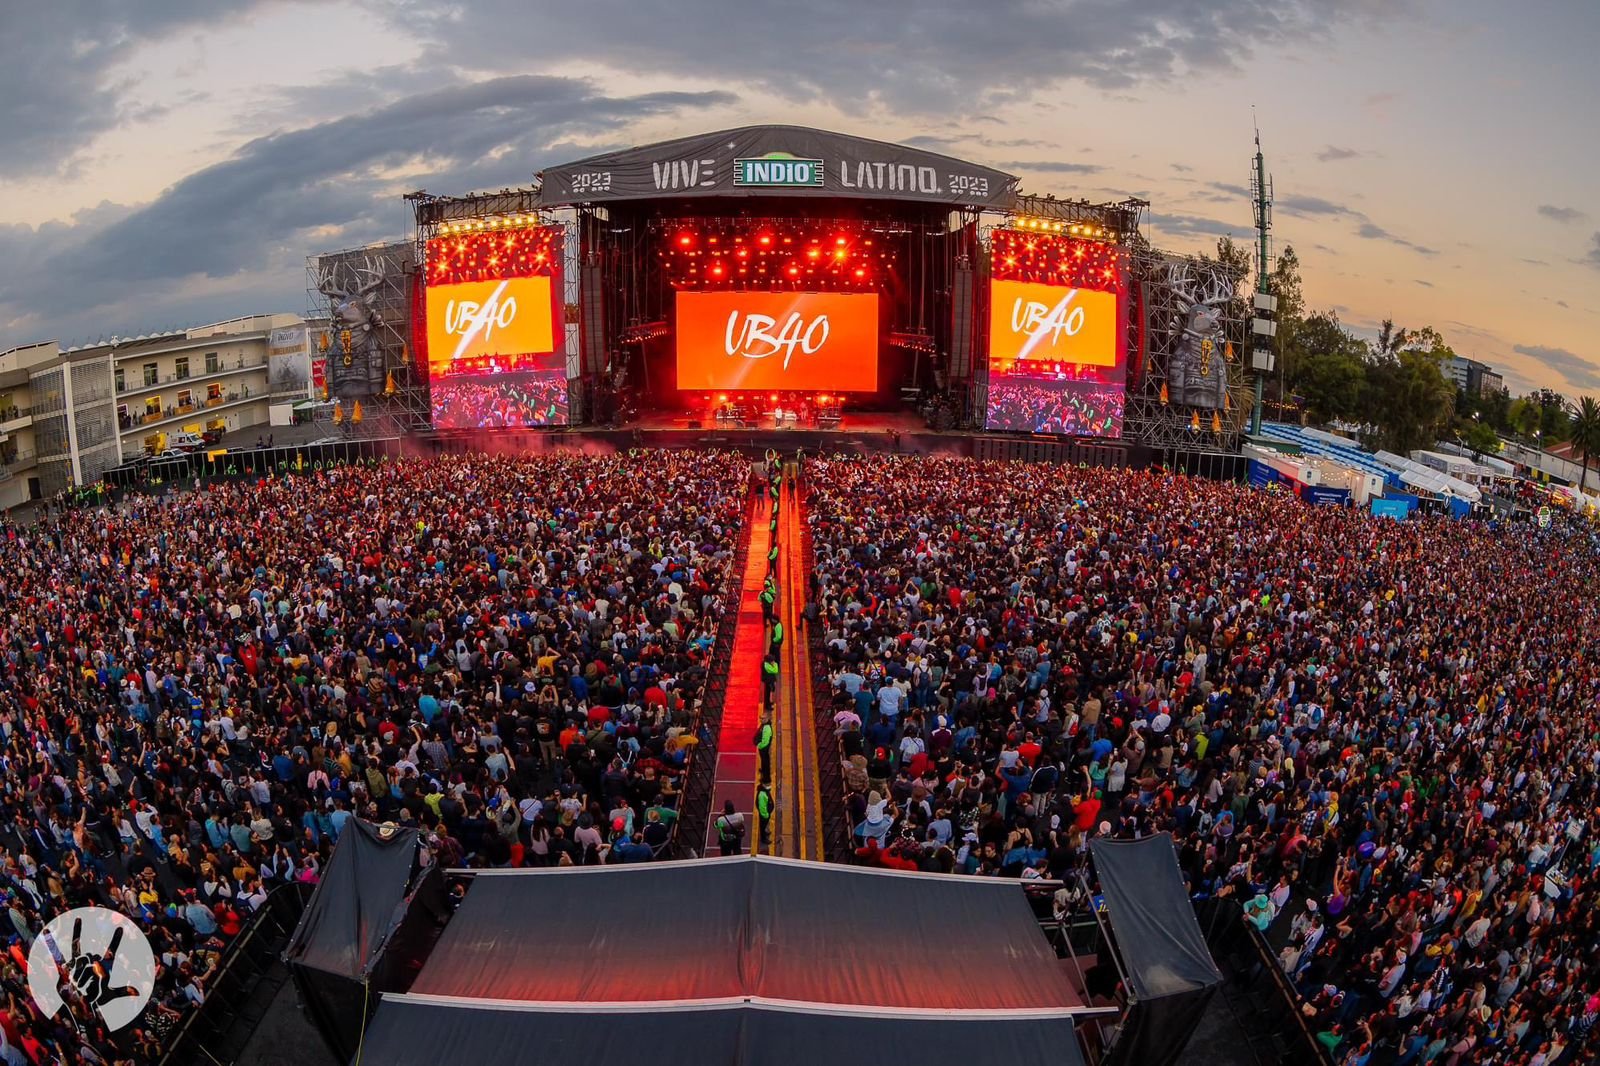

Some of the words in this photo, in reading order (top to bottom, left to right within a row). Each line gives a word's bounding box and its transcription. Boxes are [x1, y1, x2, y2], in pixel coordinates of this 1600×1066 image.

[571, 172, 611, 190] 2023
[652, 159, 716, 189] VIVE
[841, 160, 937, 194] LATINO
[948, 174, 989, 194] 2023
[746, 162, 809, 183] INDIO
[445, 296, 517, 342] UB40
[725, 310, 830, 371] UB40
[1011, 297, 1085, 347] UB40
